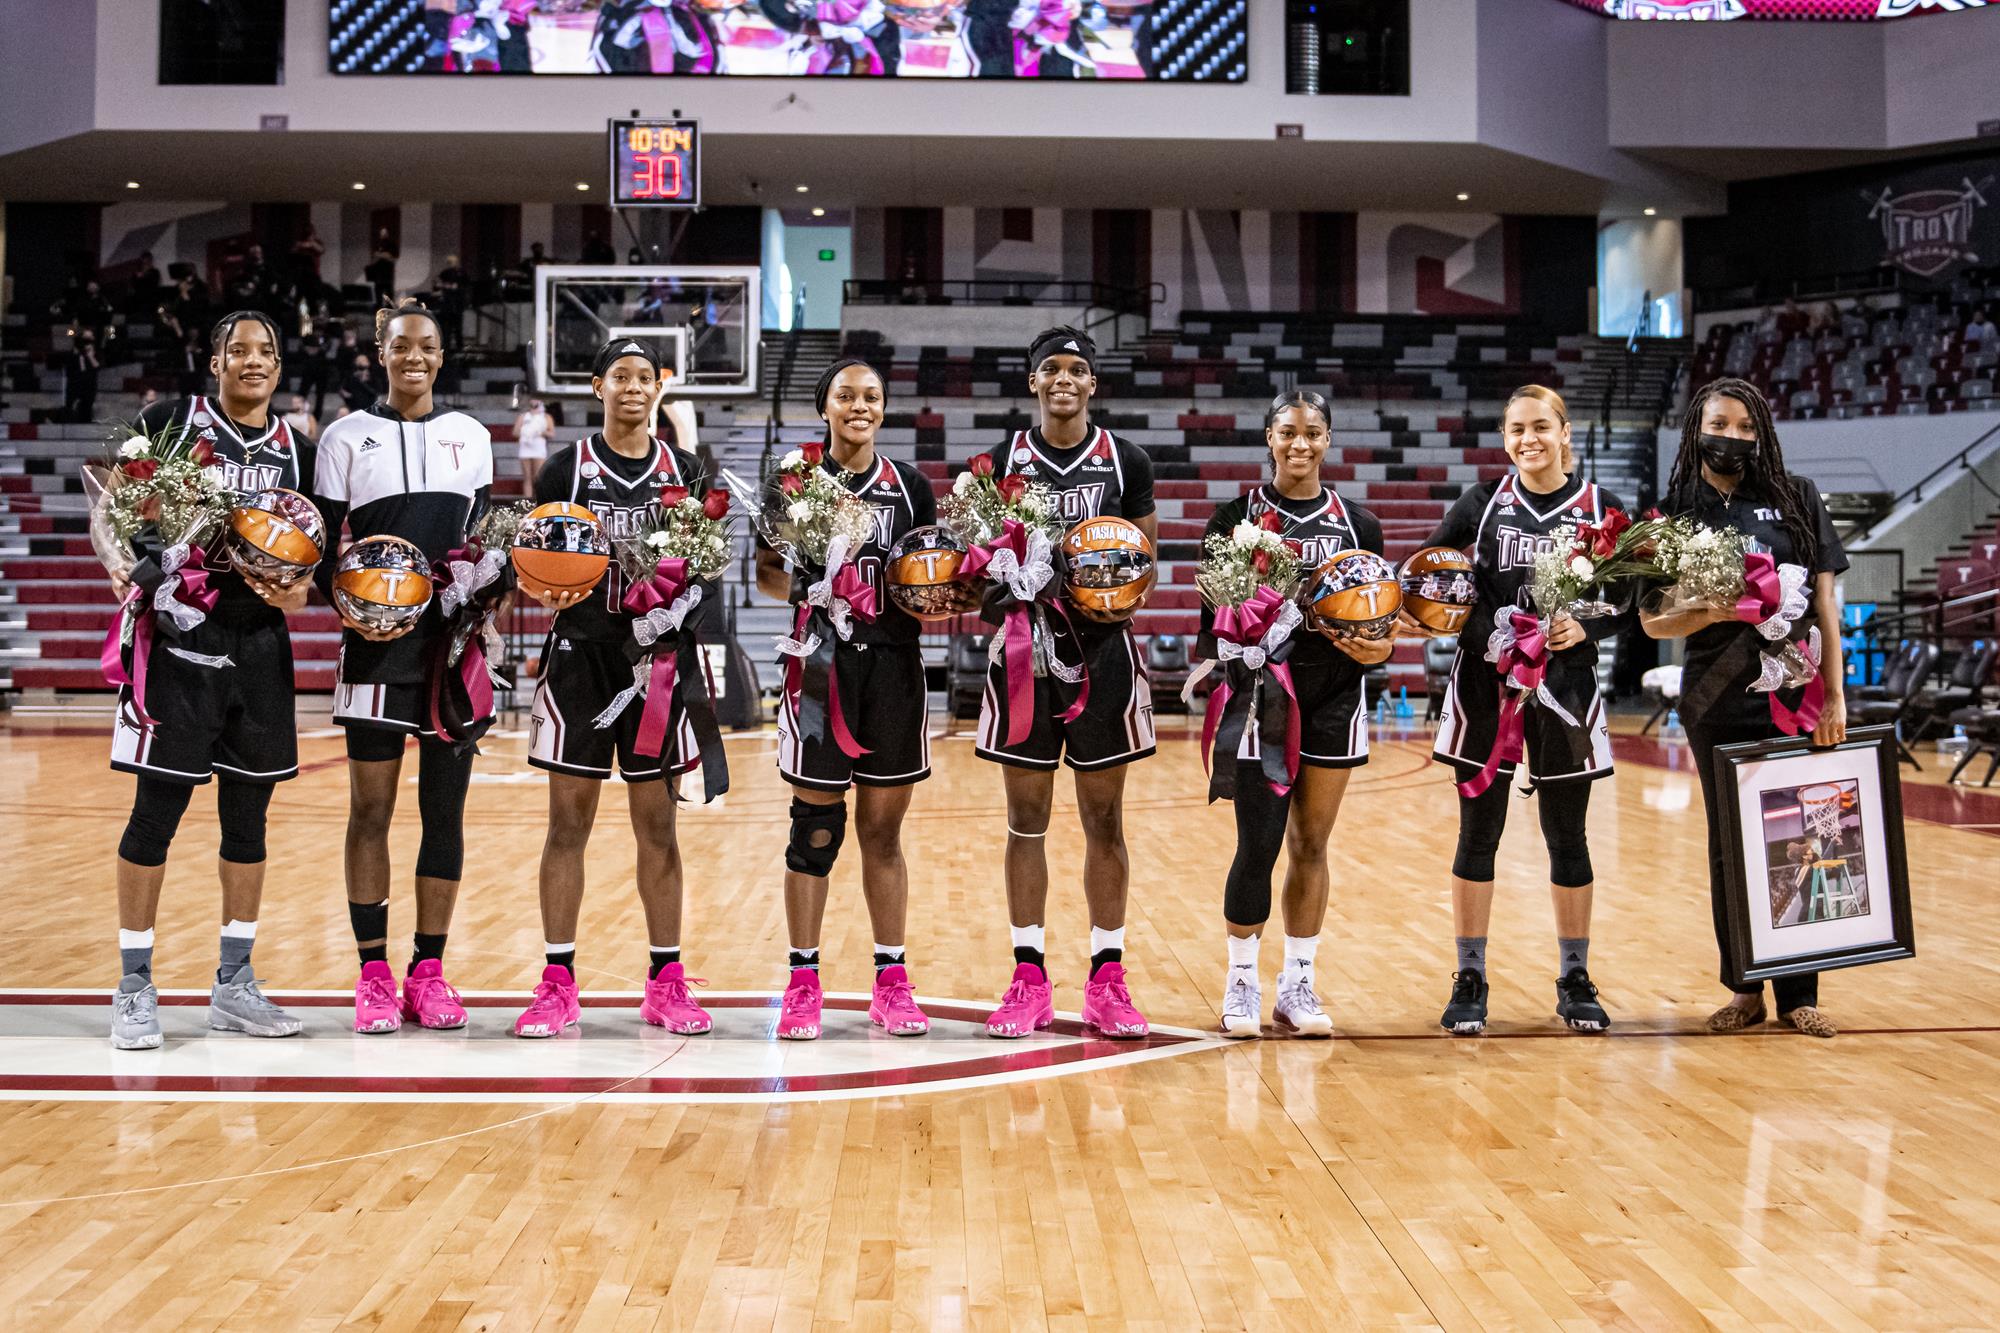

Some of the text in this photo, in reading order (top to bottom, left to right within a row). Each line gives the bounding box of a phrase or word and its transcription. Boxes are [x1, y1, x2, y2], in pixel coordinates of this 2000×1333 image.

[630, 128, 690, 152] 10:04
[632, 154, 681, 198] 30
[1895, 209, 1959, 248] TROY
[360, 443, 382, 453] adidas
[438, 440, 466, 471] T
[213, 452, 283, 495] ROY
[871, 489, 886, 497] SUN
[1045, 482, 1106, 524] ROY
[264, 516, 294, 550] T
[1069, 533, 1082, 548] #5
[1086, 525, 1116, 542] TYASIA
[1319, 519, 1349, 531] SUN BELT
[1497, 525, 1556, 572] TRO
[1983, 544, 1998, 560] T
[916, 552, 943, 582] T
[1958, 567, 1971, 583] T
[380, 572, 408, 602] T
[1094, 592, 1119, 610] T
[1358, 584, 1383, 616] T
[1443, 608, 1465, 631] T
[531, 714, 545, 750] T
